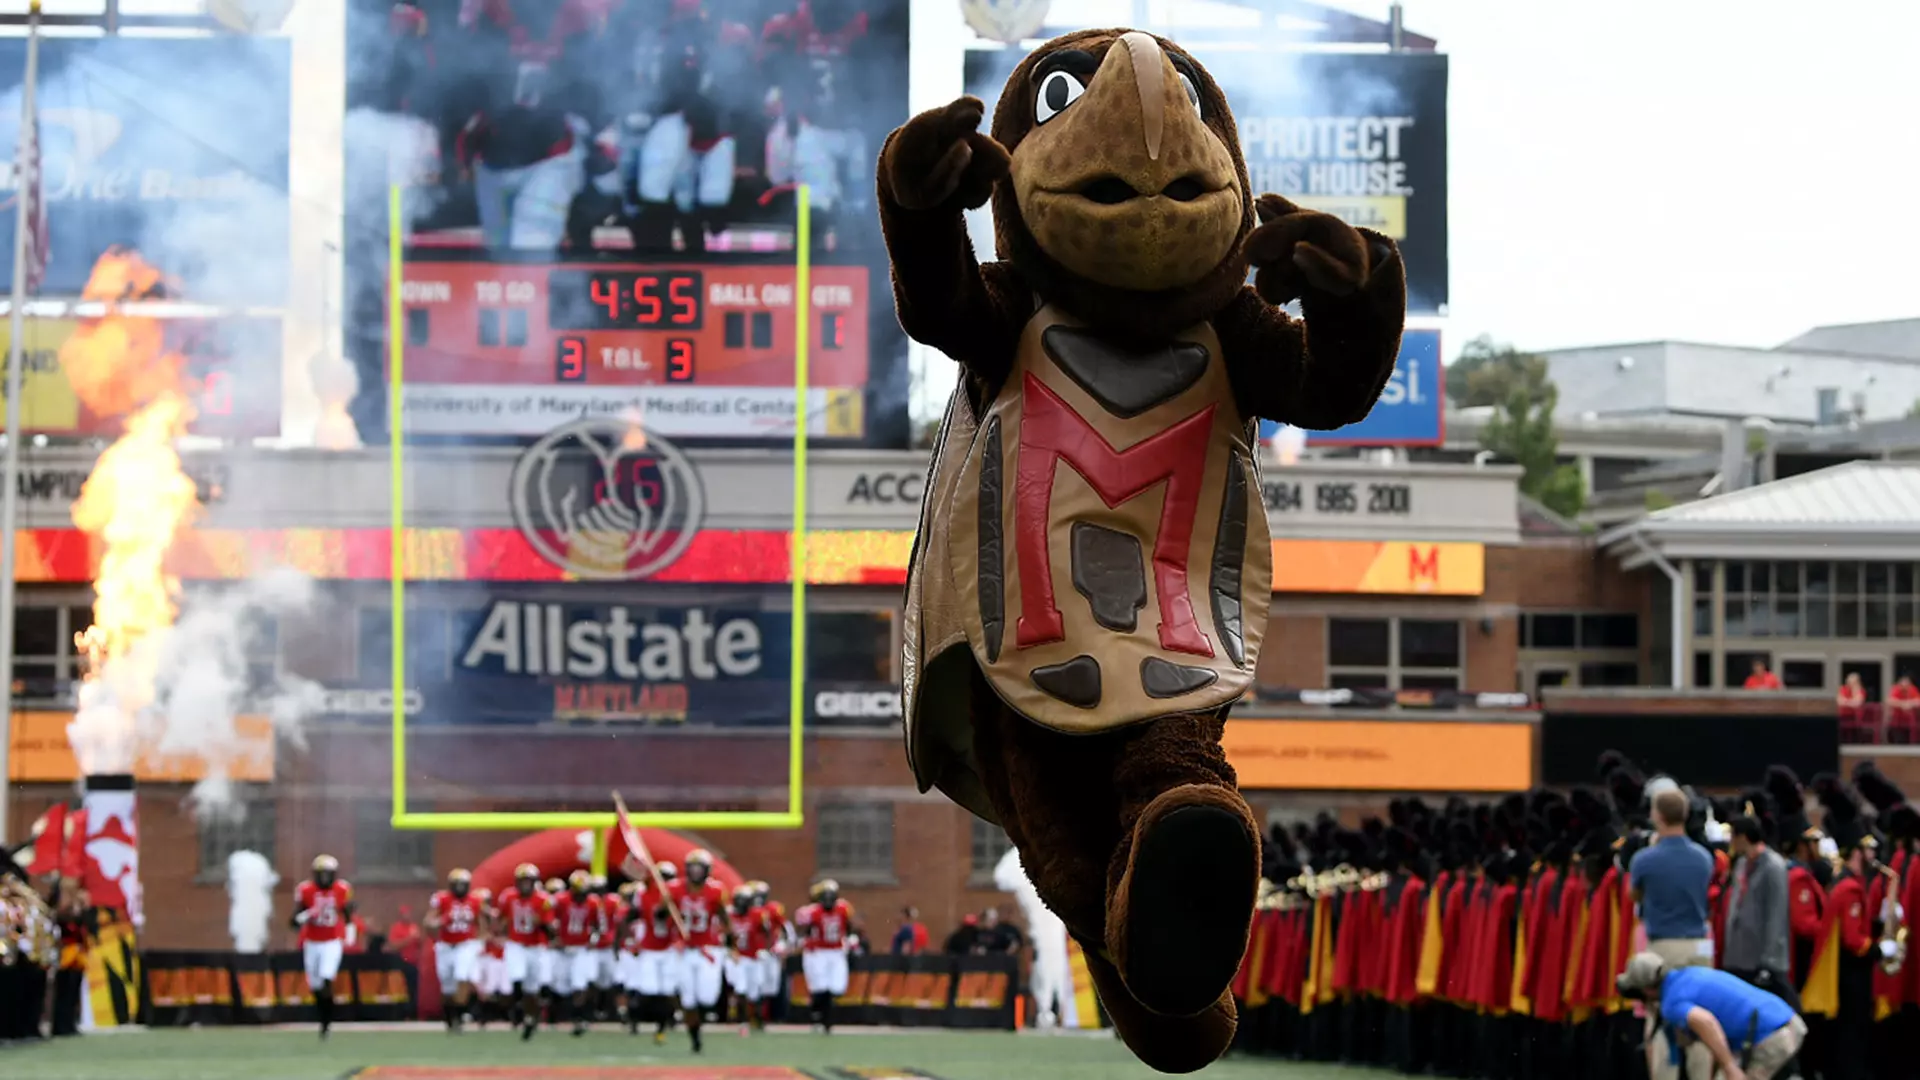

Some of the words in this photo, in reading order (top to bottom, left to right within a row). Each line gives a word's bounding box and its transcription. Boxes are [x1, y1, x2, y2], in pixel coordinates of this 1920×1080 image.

[398, 281, 452, 302] OWN
[475, 281, 502, 302] TO
[506, 281, 536, 302] GO
[590, 276, 697, 324] 4:55
[709, 283, 758, 306] BALL
[761, 283, 793, 306] ON
[811, 285, 852, 307] QTR
[561, 338, 583, 379] 3
[670, 340, 692, 380] 3
[510, 394, 532, 414] of
[647, 397, 730, 415] Medical
[733, 398, 798, 415] Cente
[846, 472, 923, 504] ACC
[1367, 484, 1411, 515] 2001
[1015, 369, 1220, 659] M
[1408, 544, 1439, 583] M
[463, 600, 763, 679] Allstate
[815, 691, 902, 717] GEIC
